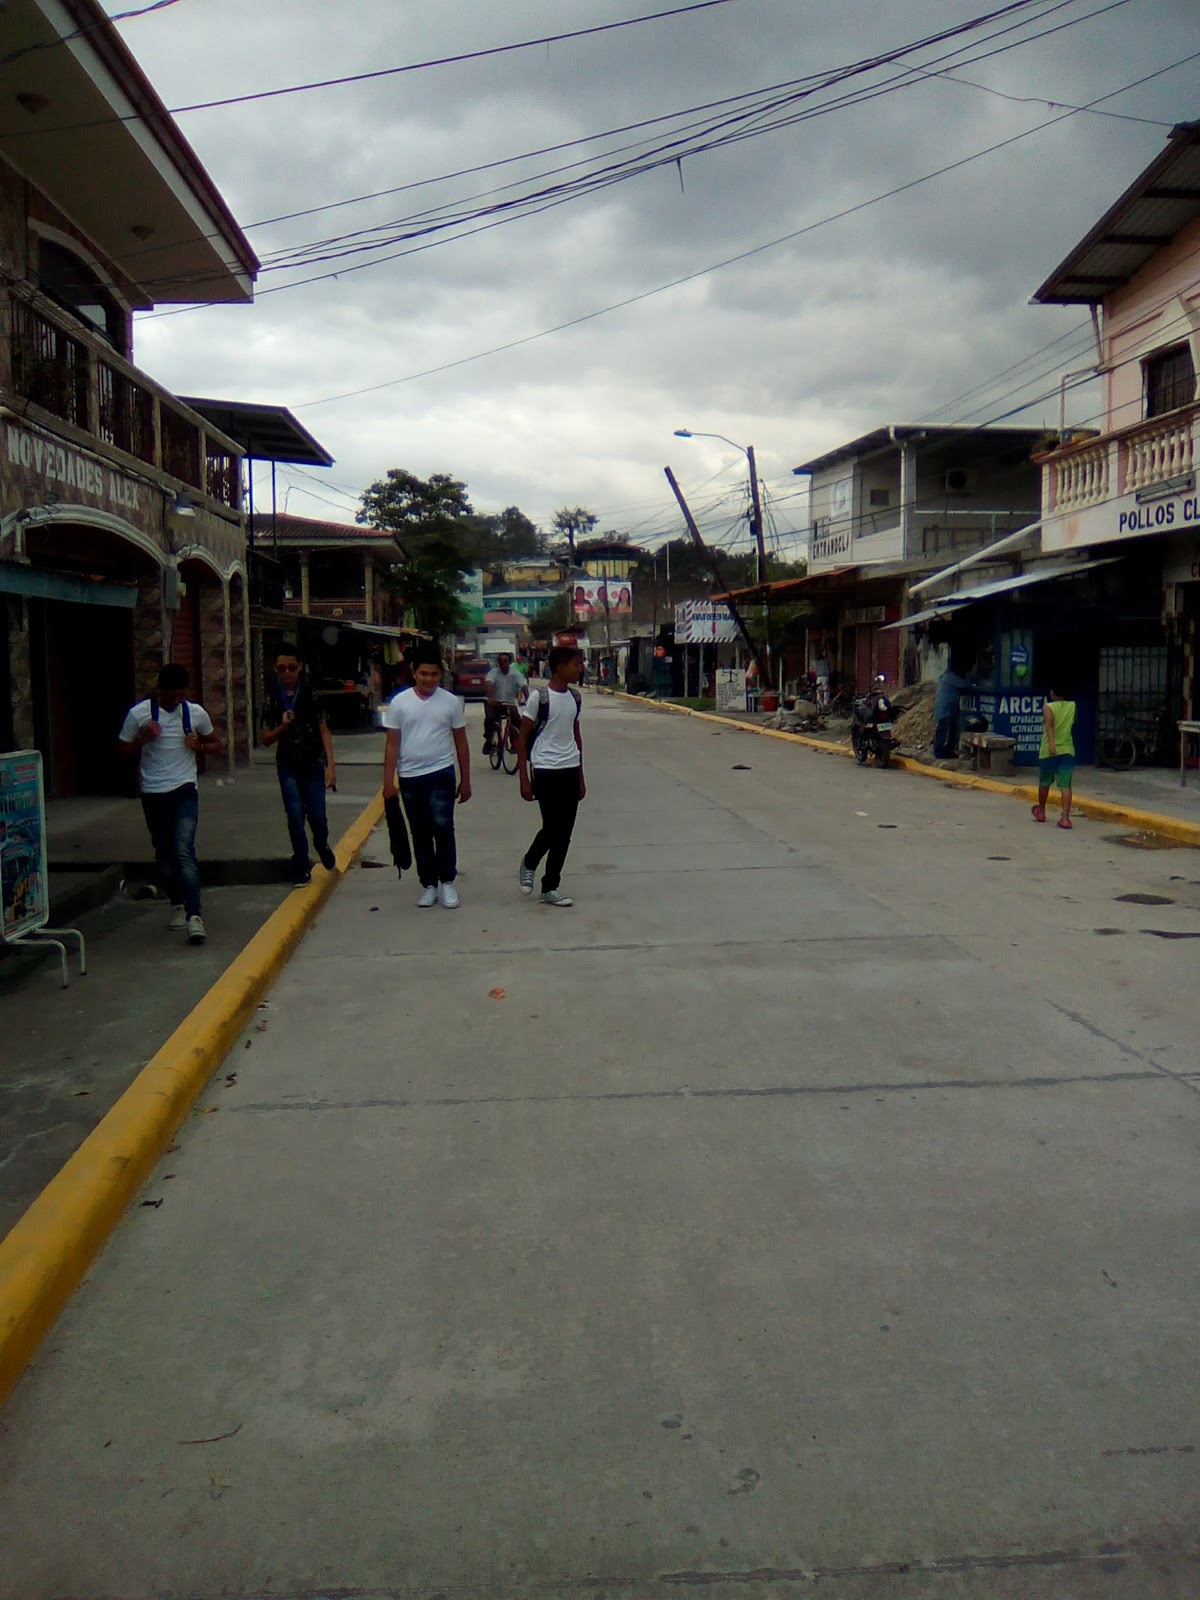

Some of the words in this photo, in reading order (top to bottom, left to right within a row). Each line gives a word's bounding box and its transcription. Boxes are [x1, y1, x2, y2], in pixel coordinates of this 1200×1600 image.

[7, 424, 103, 496] NOVEDADES
[109, 473, 139, 510] ALEX
[1119, 502, 1175, 532] POLLOS
